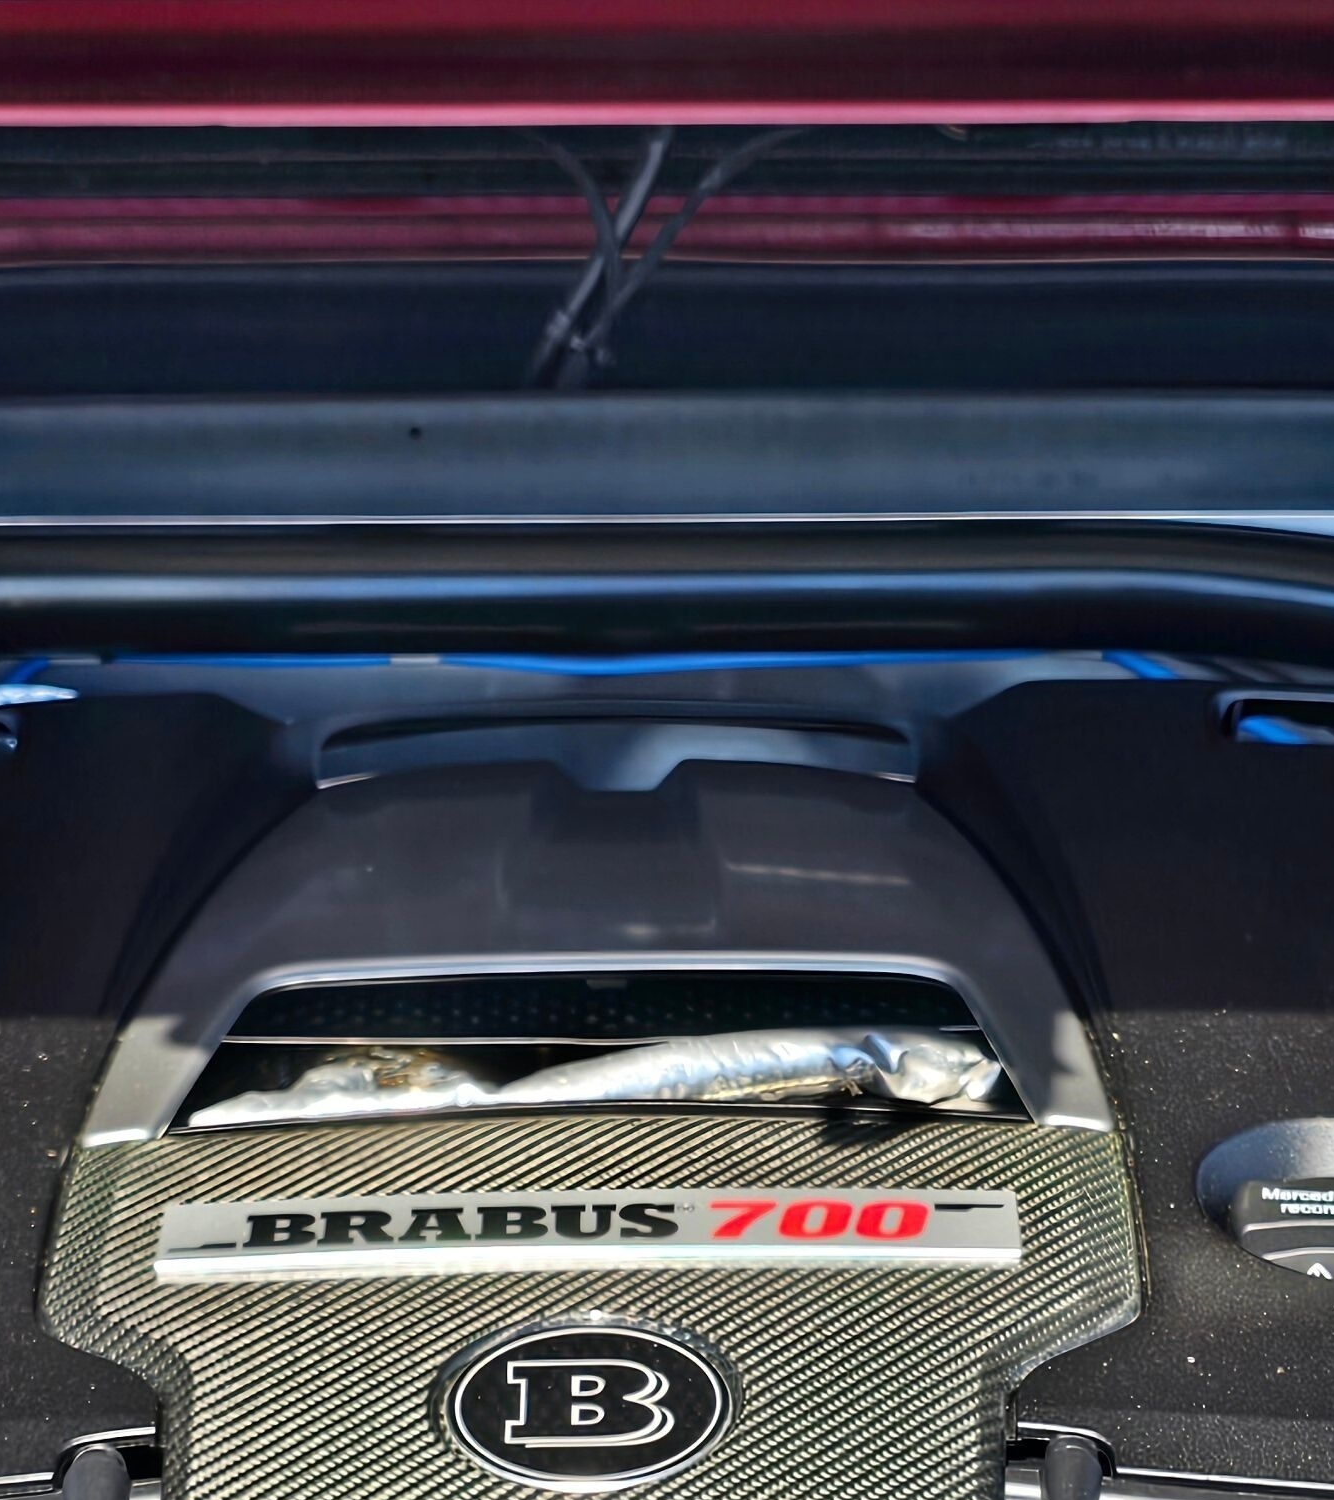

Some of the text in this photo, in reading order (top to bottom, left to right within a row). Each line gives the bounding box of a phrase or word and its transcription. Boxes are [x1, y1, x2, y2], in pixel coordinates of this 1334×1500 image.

[243, 1199, 930, 1247] BRABUS 700
[505, 1359, 675, 1448] B
